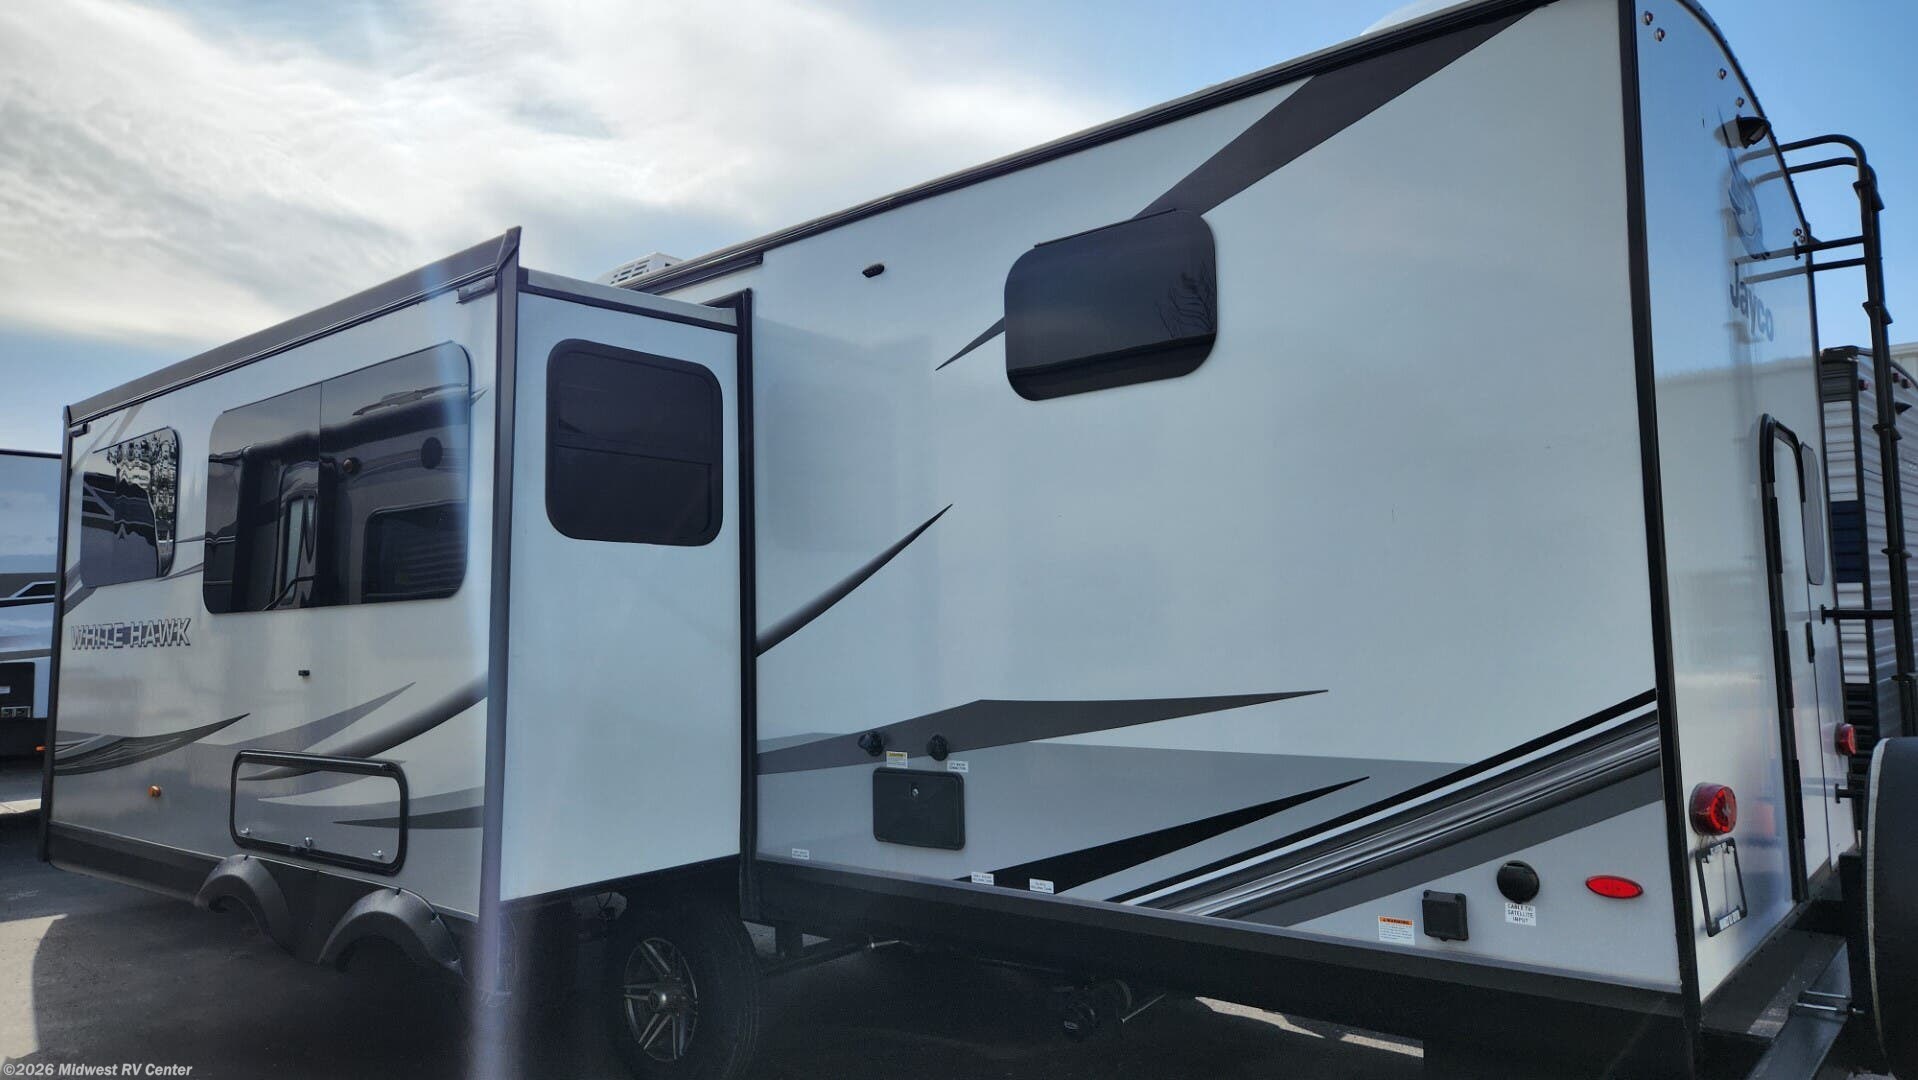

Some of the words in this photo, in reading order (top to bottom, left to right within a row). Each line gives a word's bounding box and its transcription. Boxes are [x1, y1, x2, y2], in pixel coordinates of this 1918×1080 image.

[1729, 260, 1774, 342] Jayco
[71, 622, 124, 650] WHITE
[129, 617, 191, 648] HAWK
[1507, 910, 1534, 918] SATELLITE
